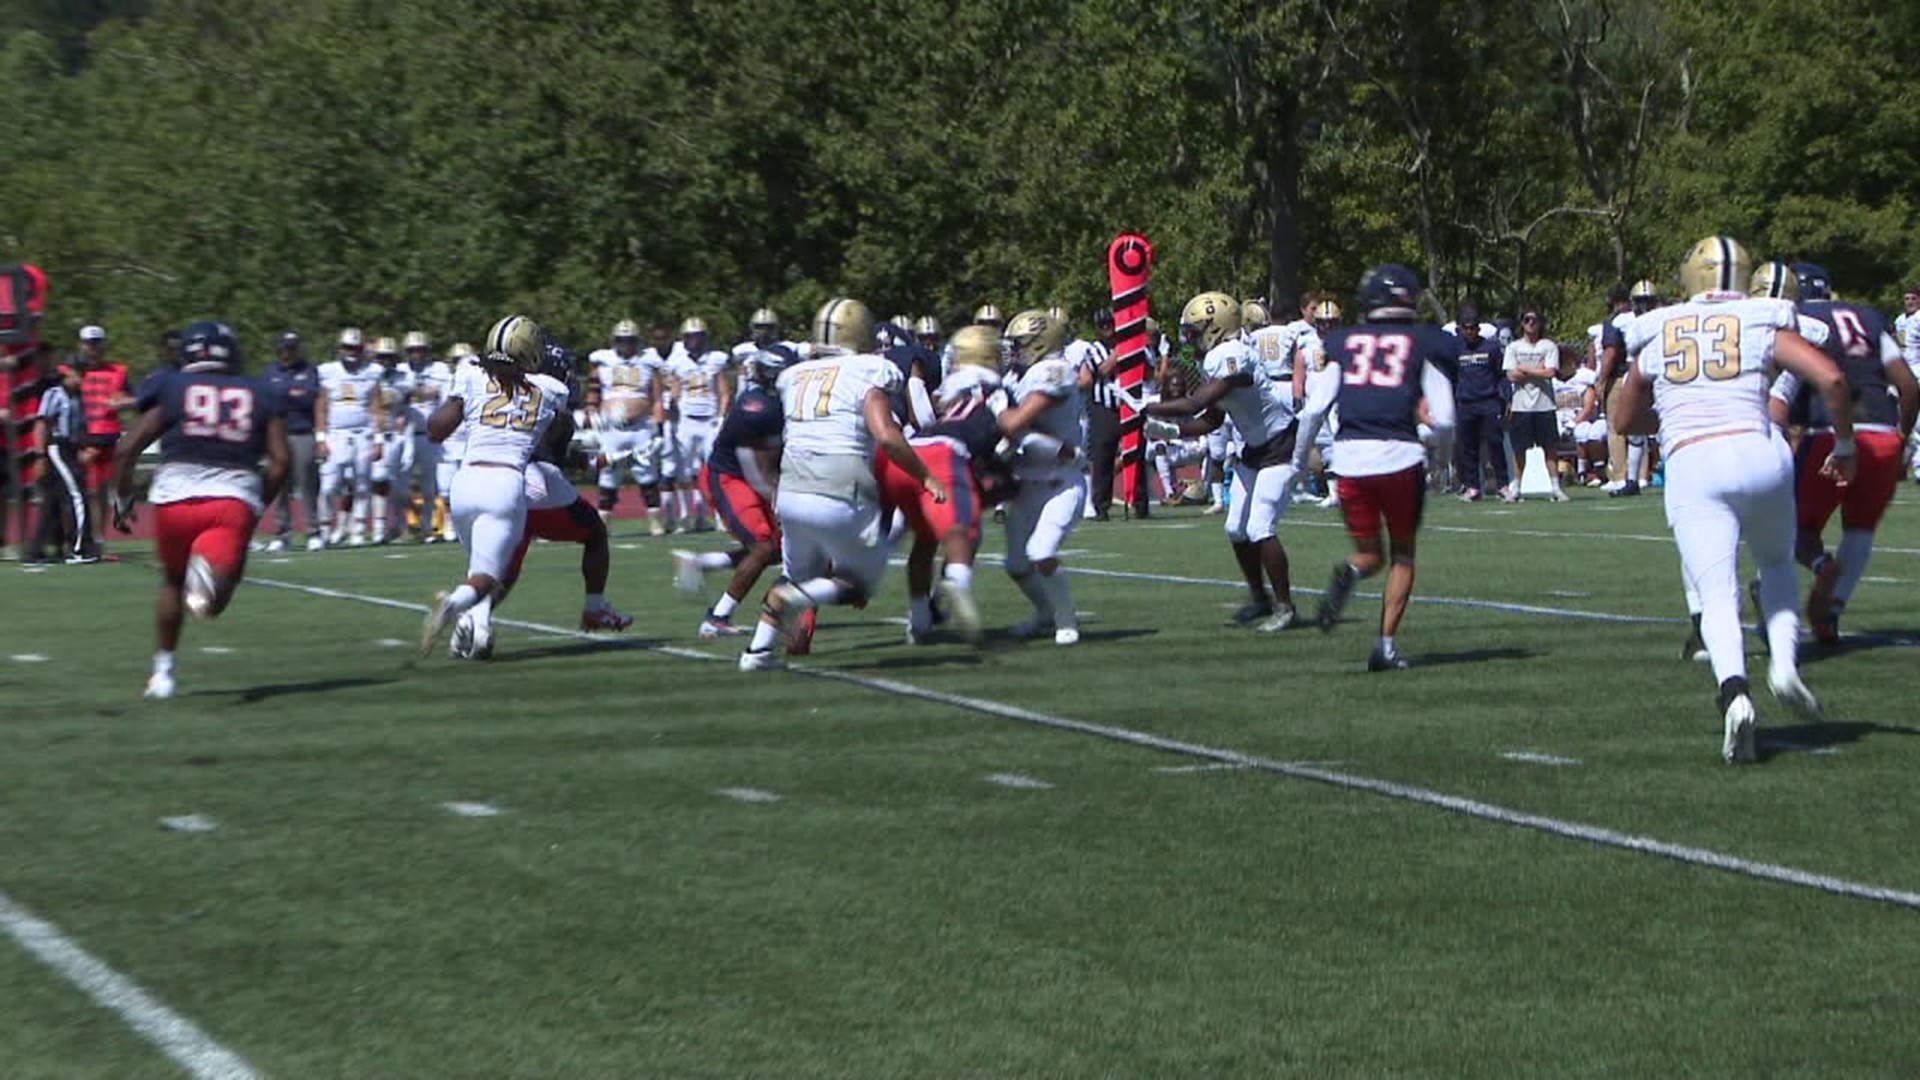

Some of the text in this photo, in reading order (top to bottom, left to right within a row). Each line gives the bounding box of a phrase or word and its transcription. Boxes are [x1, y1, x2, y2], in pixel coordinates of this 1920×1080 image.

[1259, 333, 1280, 362] 15
[1343, 333, 1411, 388] 33
[1662, 314, 1741, 385] 53
[182, 384, 254, 442] 93
[480, 379, 542, 432] 23
[790, 366, 840, 422] 77
